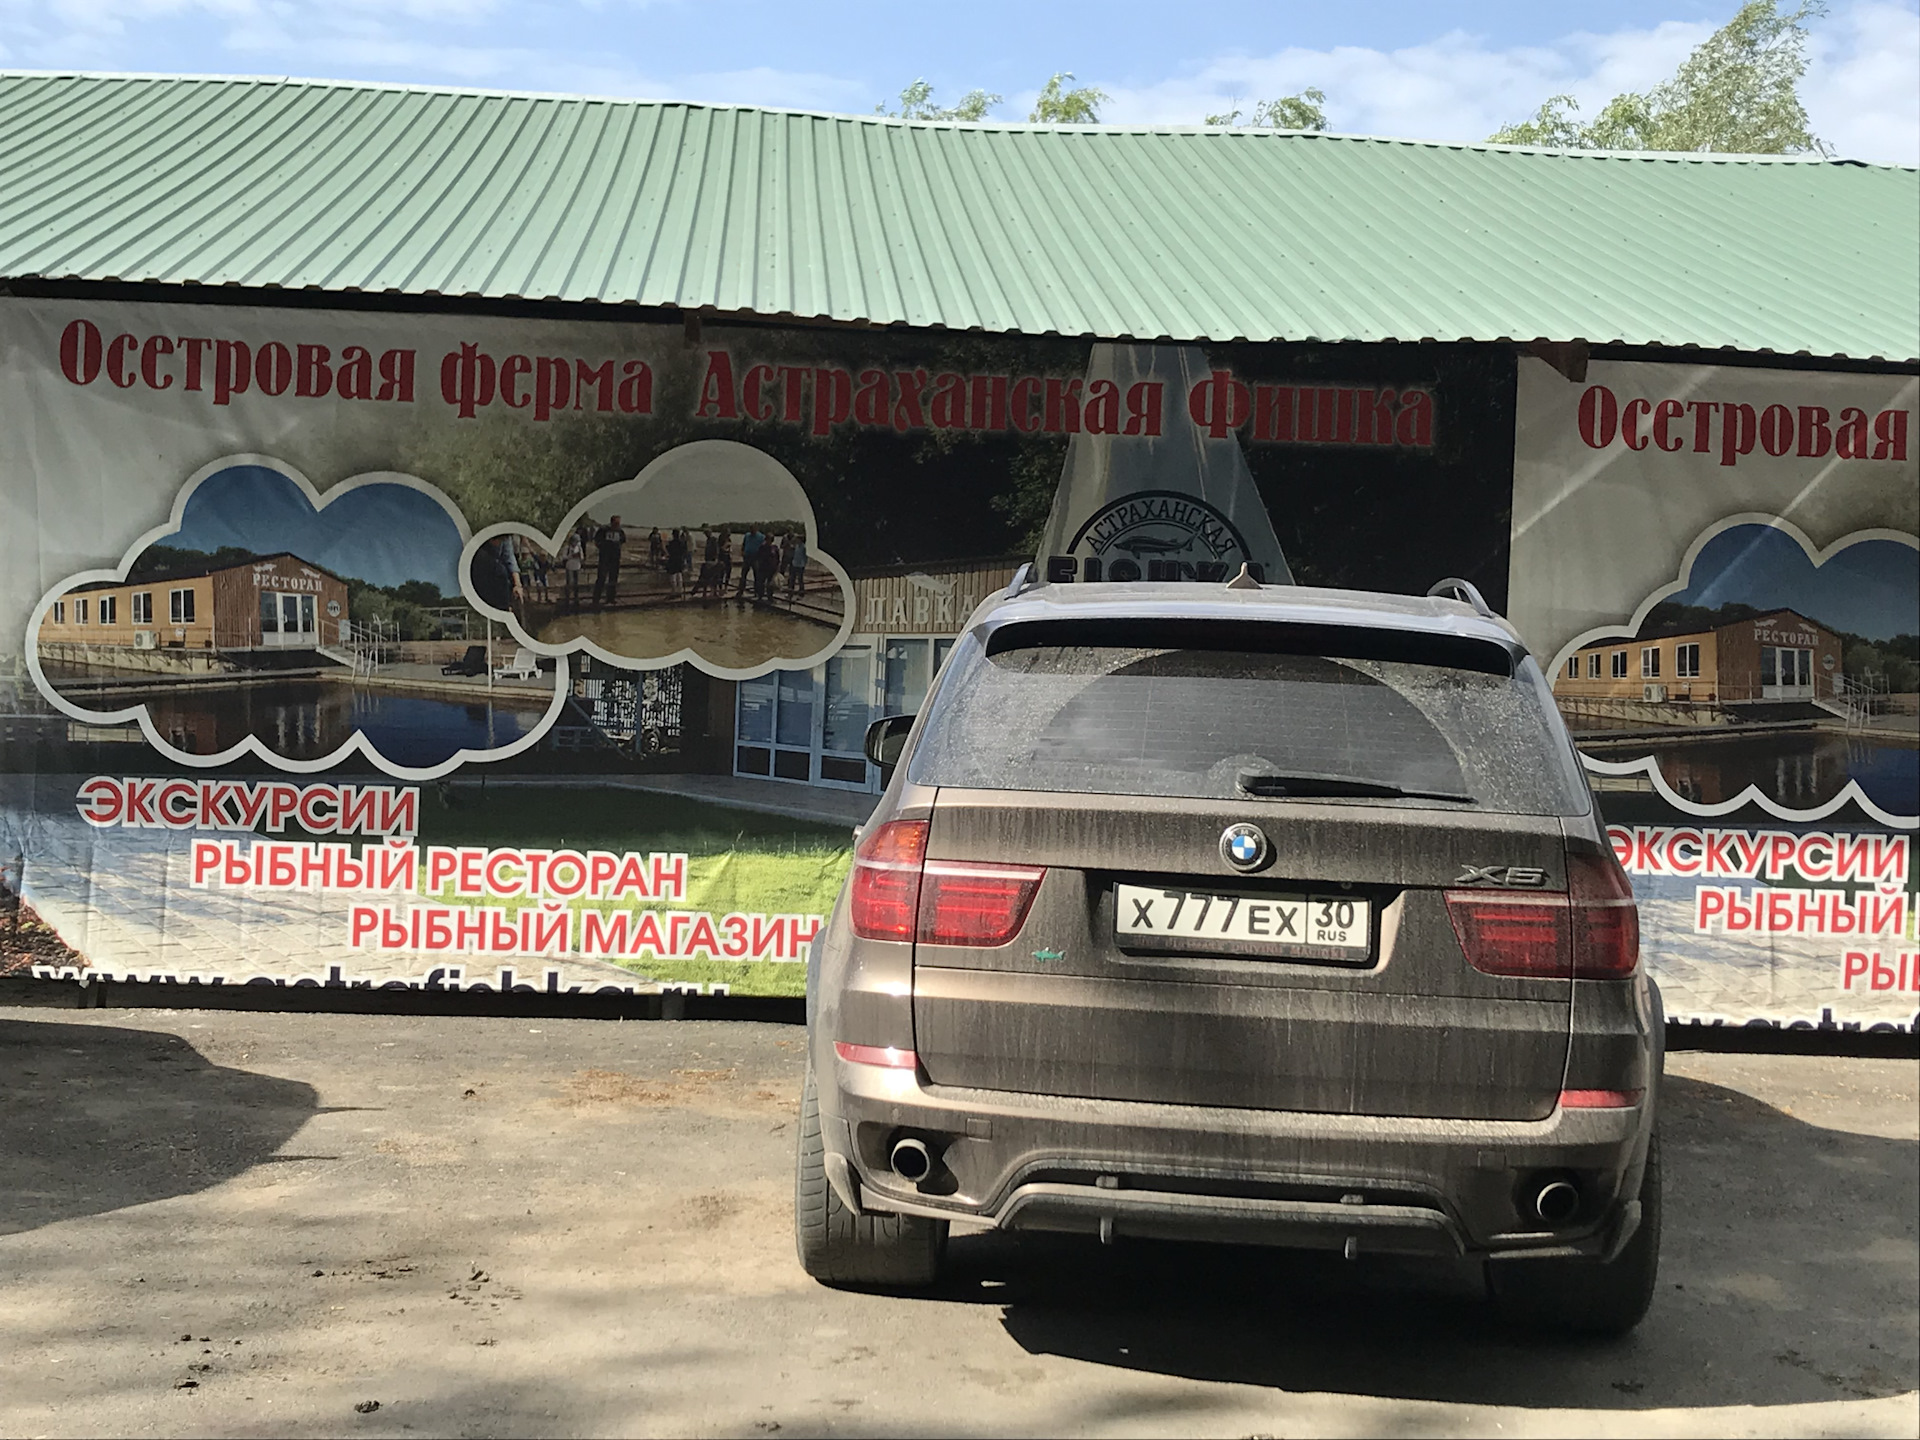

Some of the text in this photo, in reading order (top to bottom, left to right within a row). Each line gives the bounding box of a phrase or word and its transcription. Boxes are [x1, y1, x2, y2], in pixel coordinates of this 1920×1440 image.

[59, 319, 1433, 446] Осетровая ферма Астраханская Фишка
[1578, 385, 1909, 466] Осетровая
[1085, 499, 1238, 555] АСТРАХАНСКАЯ
[252, 573, 323, 592] РЕСТОРАН
[1753, 628, 1819, 646] РЕСТОРАН
[81, 780, 417, 833] ЭКСКУРСИИ
[194, 841, 687, 901] РЫБНЫЙ РЕСТОРАН
[1454, 864, 1545, 886] X5
[352, 900, 820, 960] РЫБНЫЙ МАГАЗИН
[1314, 899, 1355, 930] 30
[1699, 887, 1904, 934] РЫБНЫЙ
[1316, 930, 1347, 943] RUS
